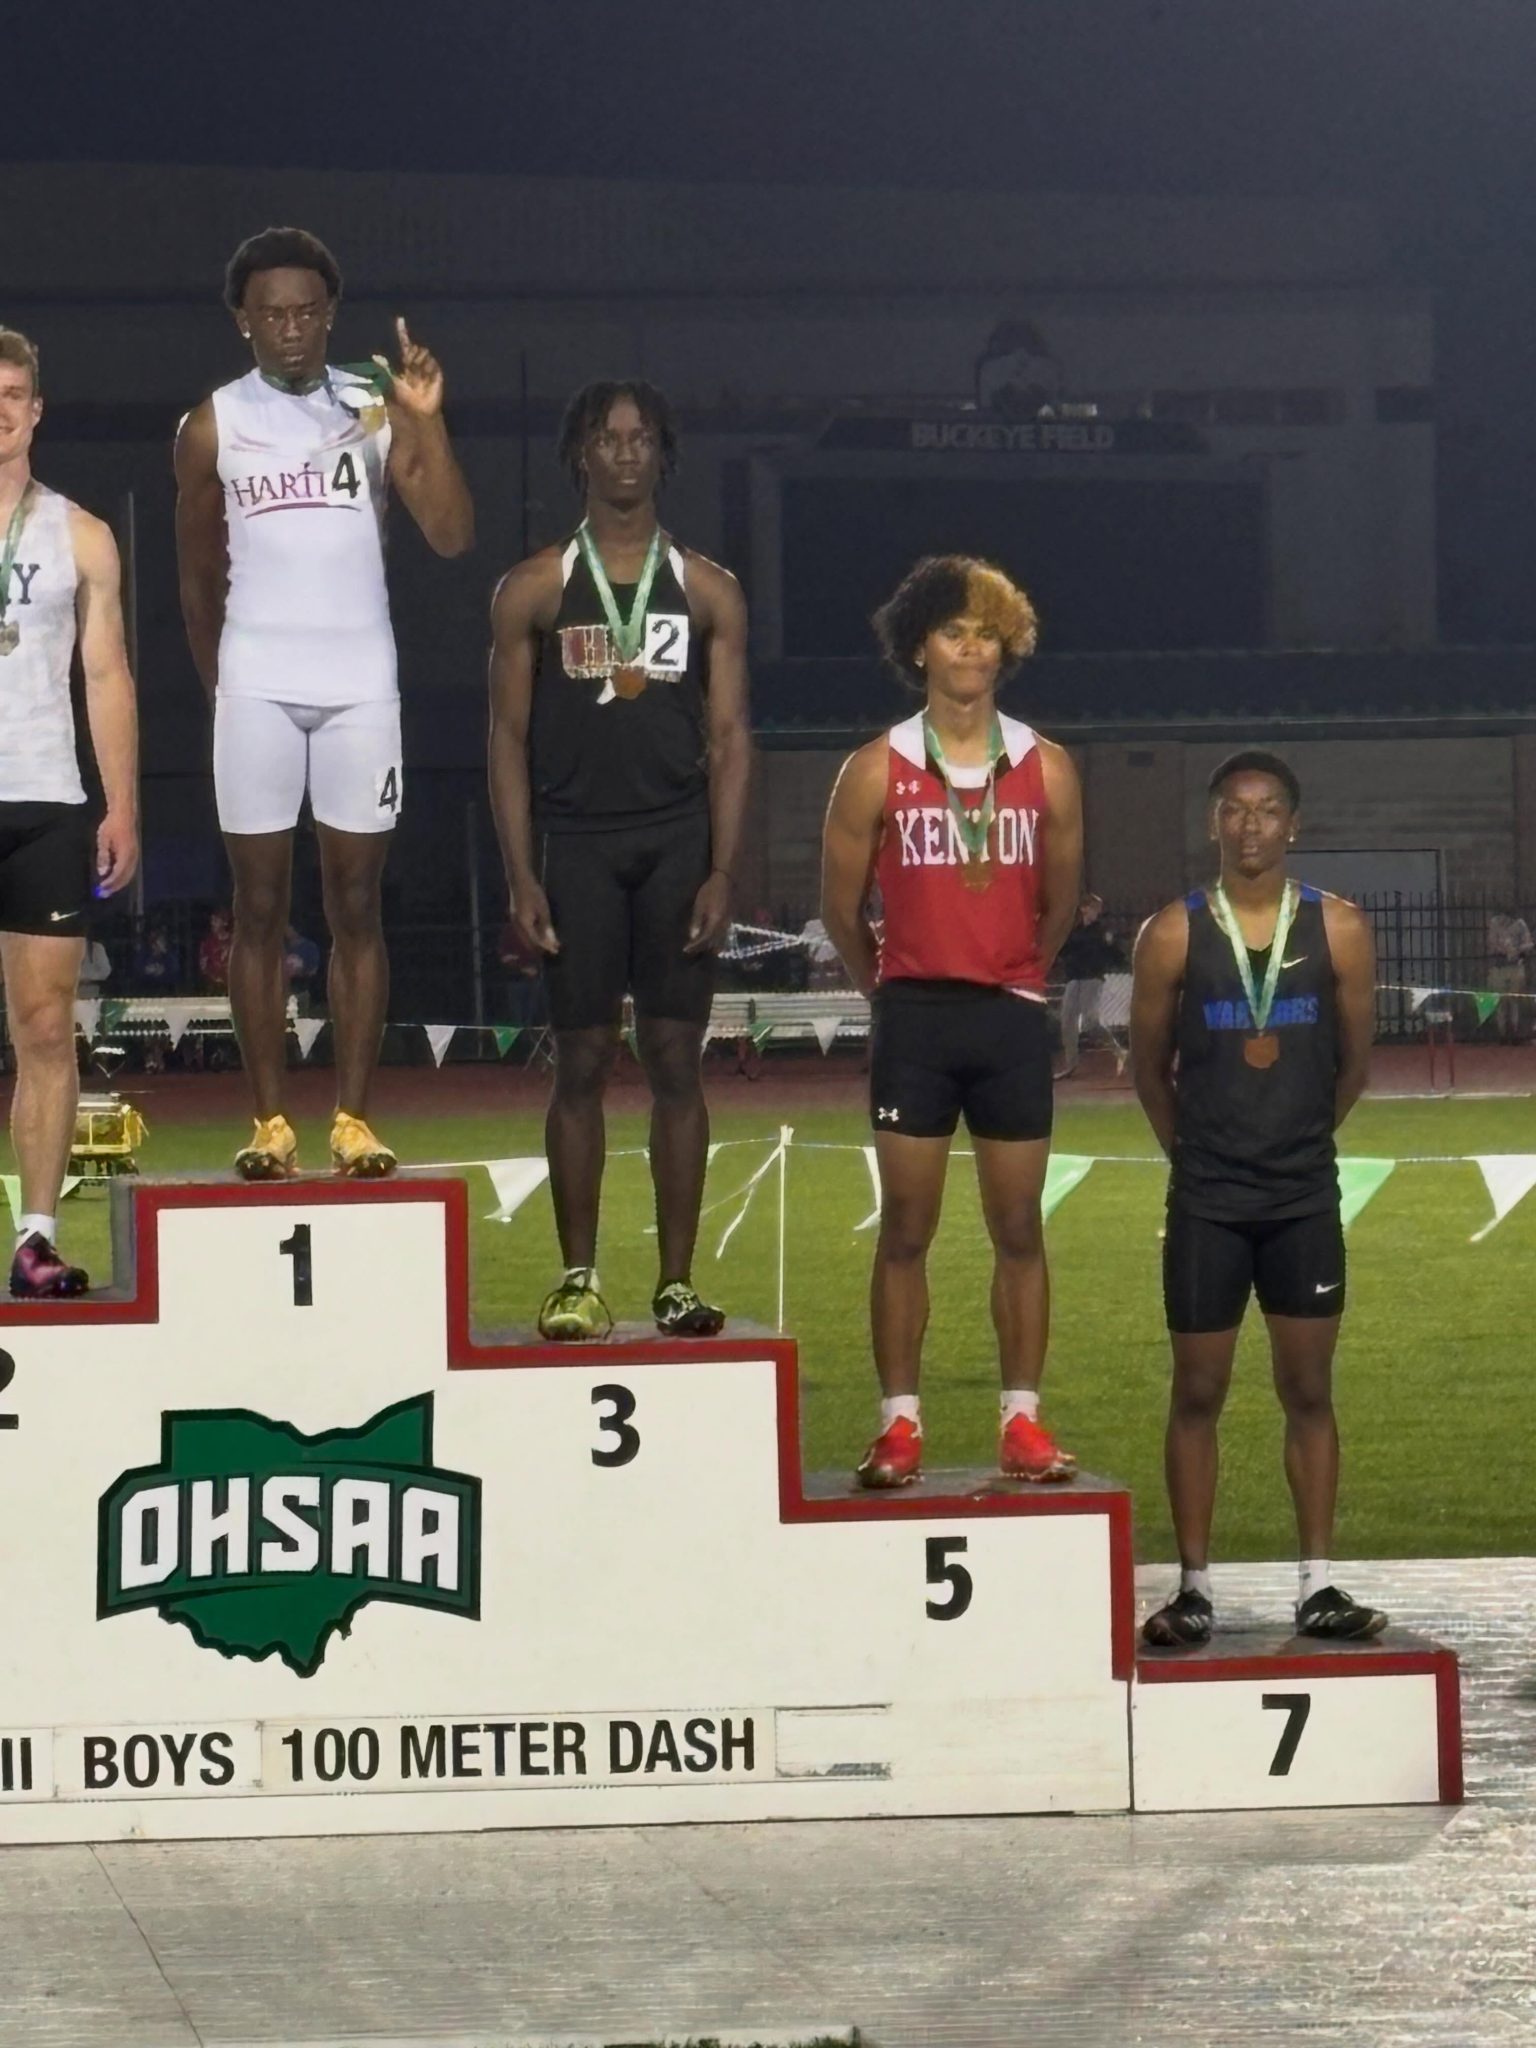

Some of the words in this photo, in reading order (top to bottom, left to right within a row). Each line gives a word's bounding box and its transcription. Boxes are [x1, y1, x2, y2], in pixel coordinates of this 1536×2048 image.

[911, 422, 1036, 450] BUCKEYE
[1040, 422, 1115, 451] FIELD
[331, 451, 362, 500] 4
[651, 618, 680, 666] 2
[378, 766, 399, 814] 4
[1203, 996, 1319, 1030] WARORS
[279, 1224, 313, 1306] 1
[591, 1384, 641, 1468] 3
[120, 1475, 461, 1591] OHSAA
[925, 1536, 973, 1621] 5
[83, 1732, 235, 1790] BOYS
[282, 1727, 380, 1782] 100
[400, 1721, 587, 1779] METER
[609, 1717, 755, 1774] DASH
[1261, 1693, 1311, 1776] 7
